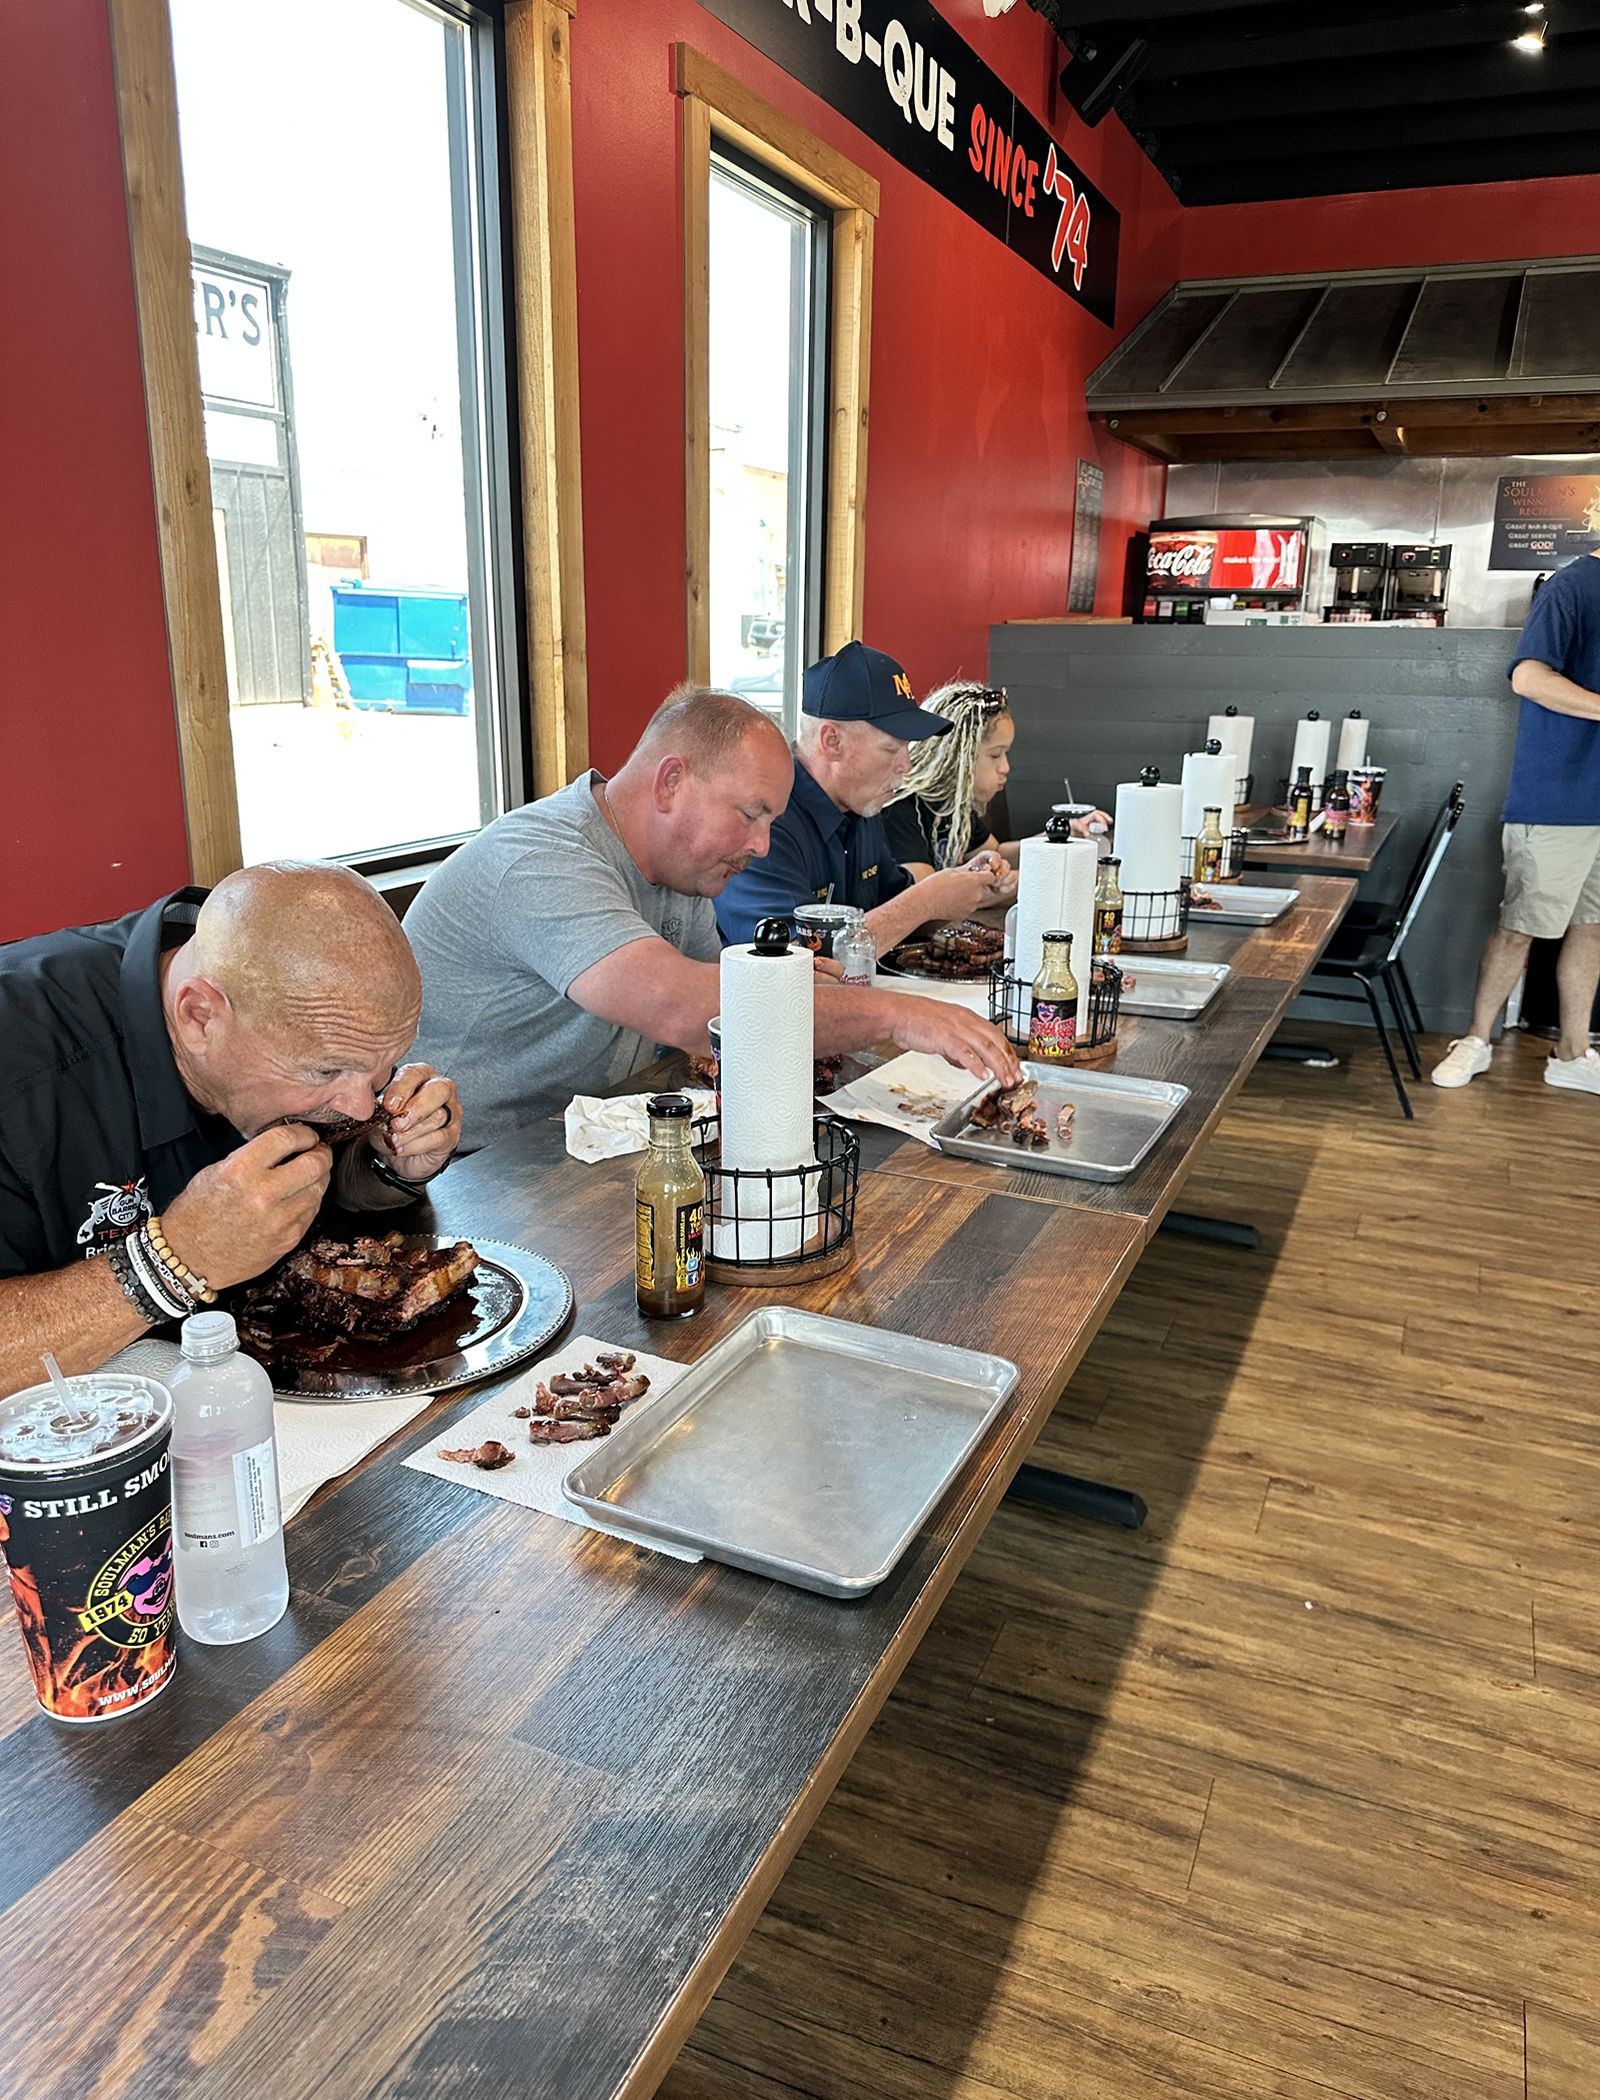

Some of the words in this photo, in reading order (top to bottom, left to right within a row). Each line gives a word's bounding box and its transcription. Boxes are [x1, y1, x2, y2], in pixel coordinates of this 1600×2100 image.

[968, 103, 1039, 218] SINCE
[1043, 142, 1091, 292] '74
[201, 281, 261, 346] R'S
[1503, 485, 1576, 497] SOULMN'S
[118, 1211, 134, 1221] CITY
[119, 1197, 135, 1207] GUN
[85, 1243, 108, 1260] Bri
[23, 1488, 118, 1519] STILL
[124, 1446, 170, 1499] SMO
[94, 1524, 156, 1597] SOULMAN'S
[85, 1595, 129, 1625] 1974
